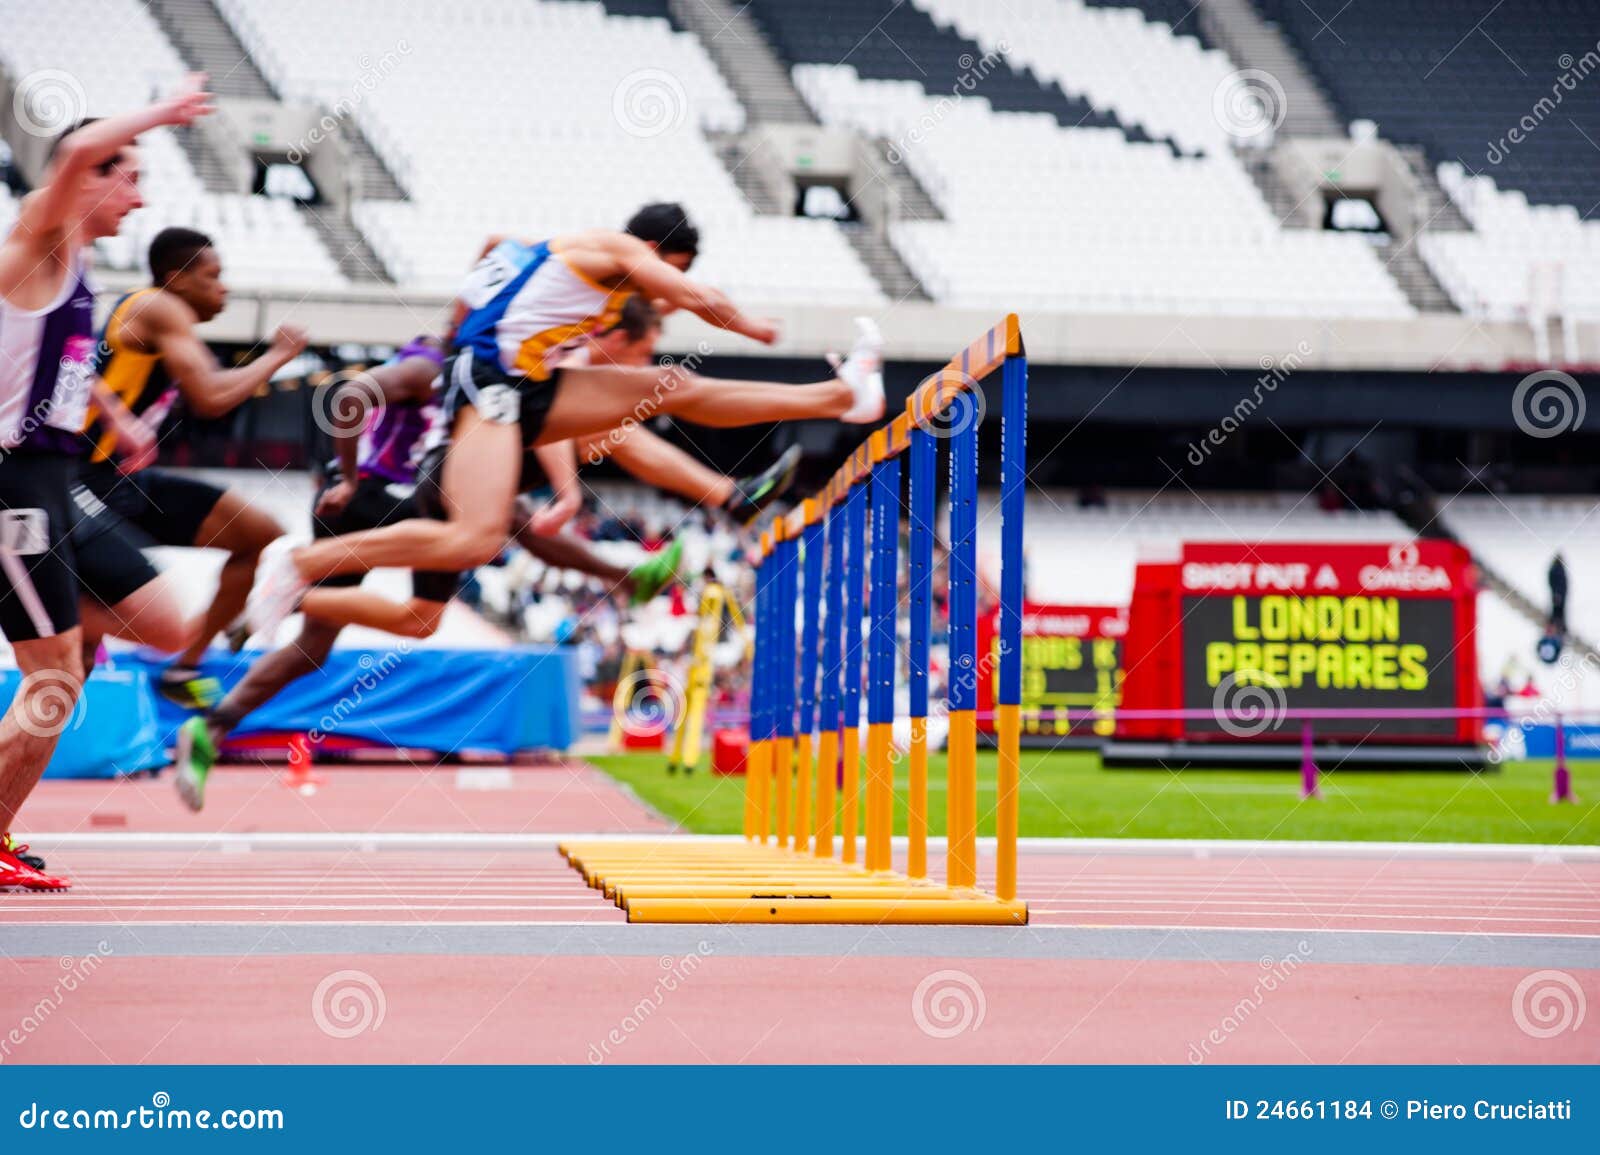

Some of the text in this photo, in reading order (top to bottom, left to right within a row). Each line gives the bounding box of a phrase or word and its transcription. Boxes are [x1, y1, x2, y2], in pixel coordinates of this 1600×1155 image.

[1182, 562, 1340, 590] SHOT PUT A
[1358, 565, 1451, 591] OMEGA
[1233, 595, 1399, 642] LONDON
[1206, 642, 1429, 690] PREPARES
